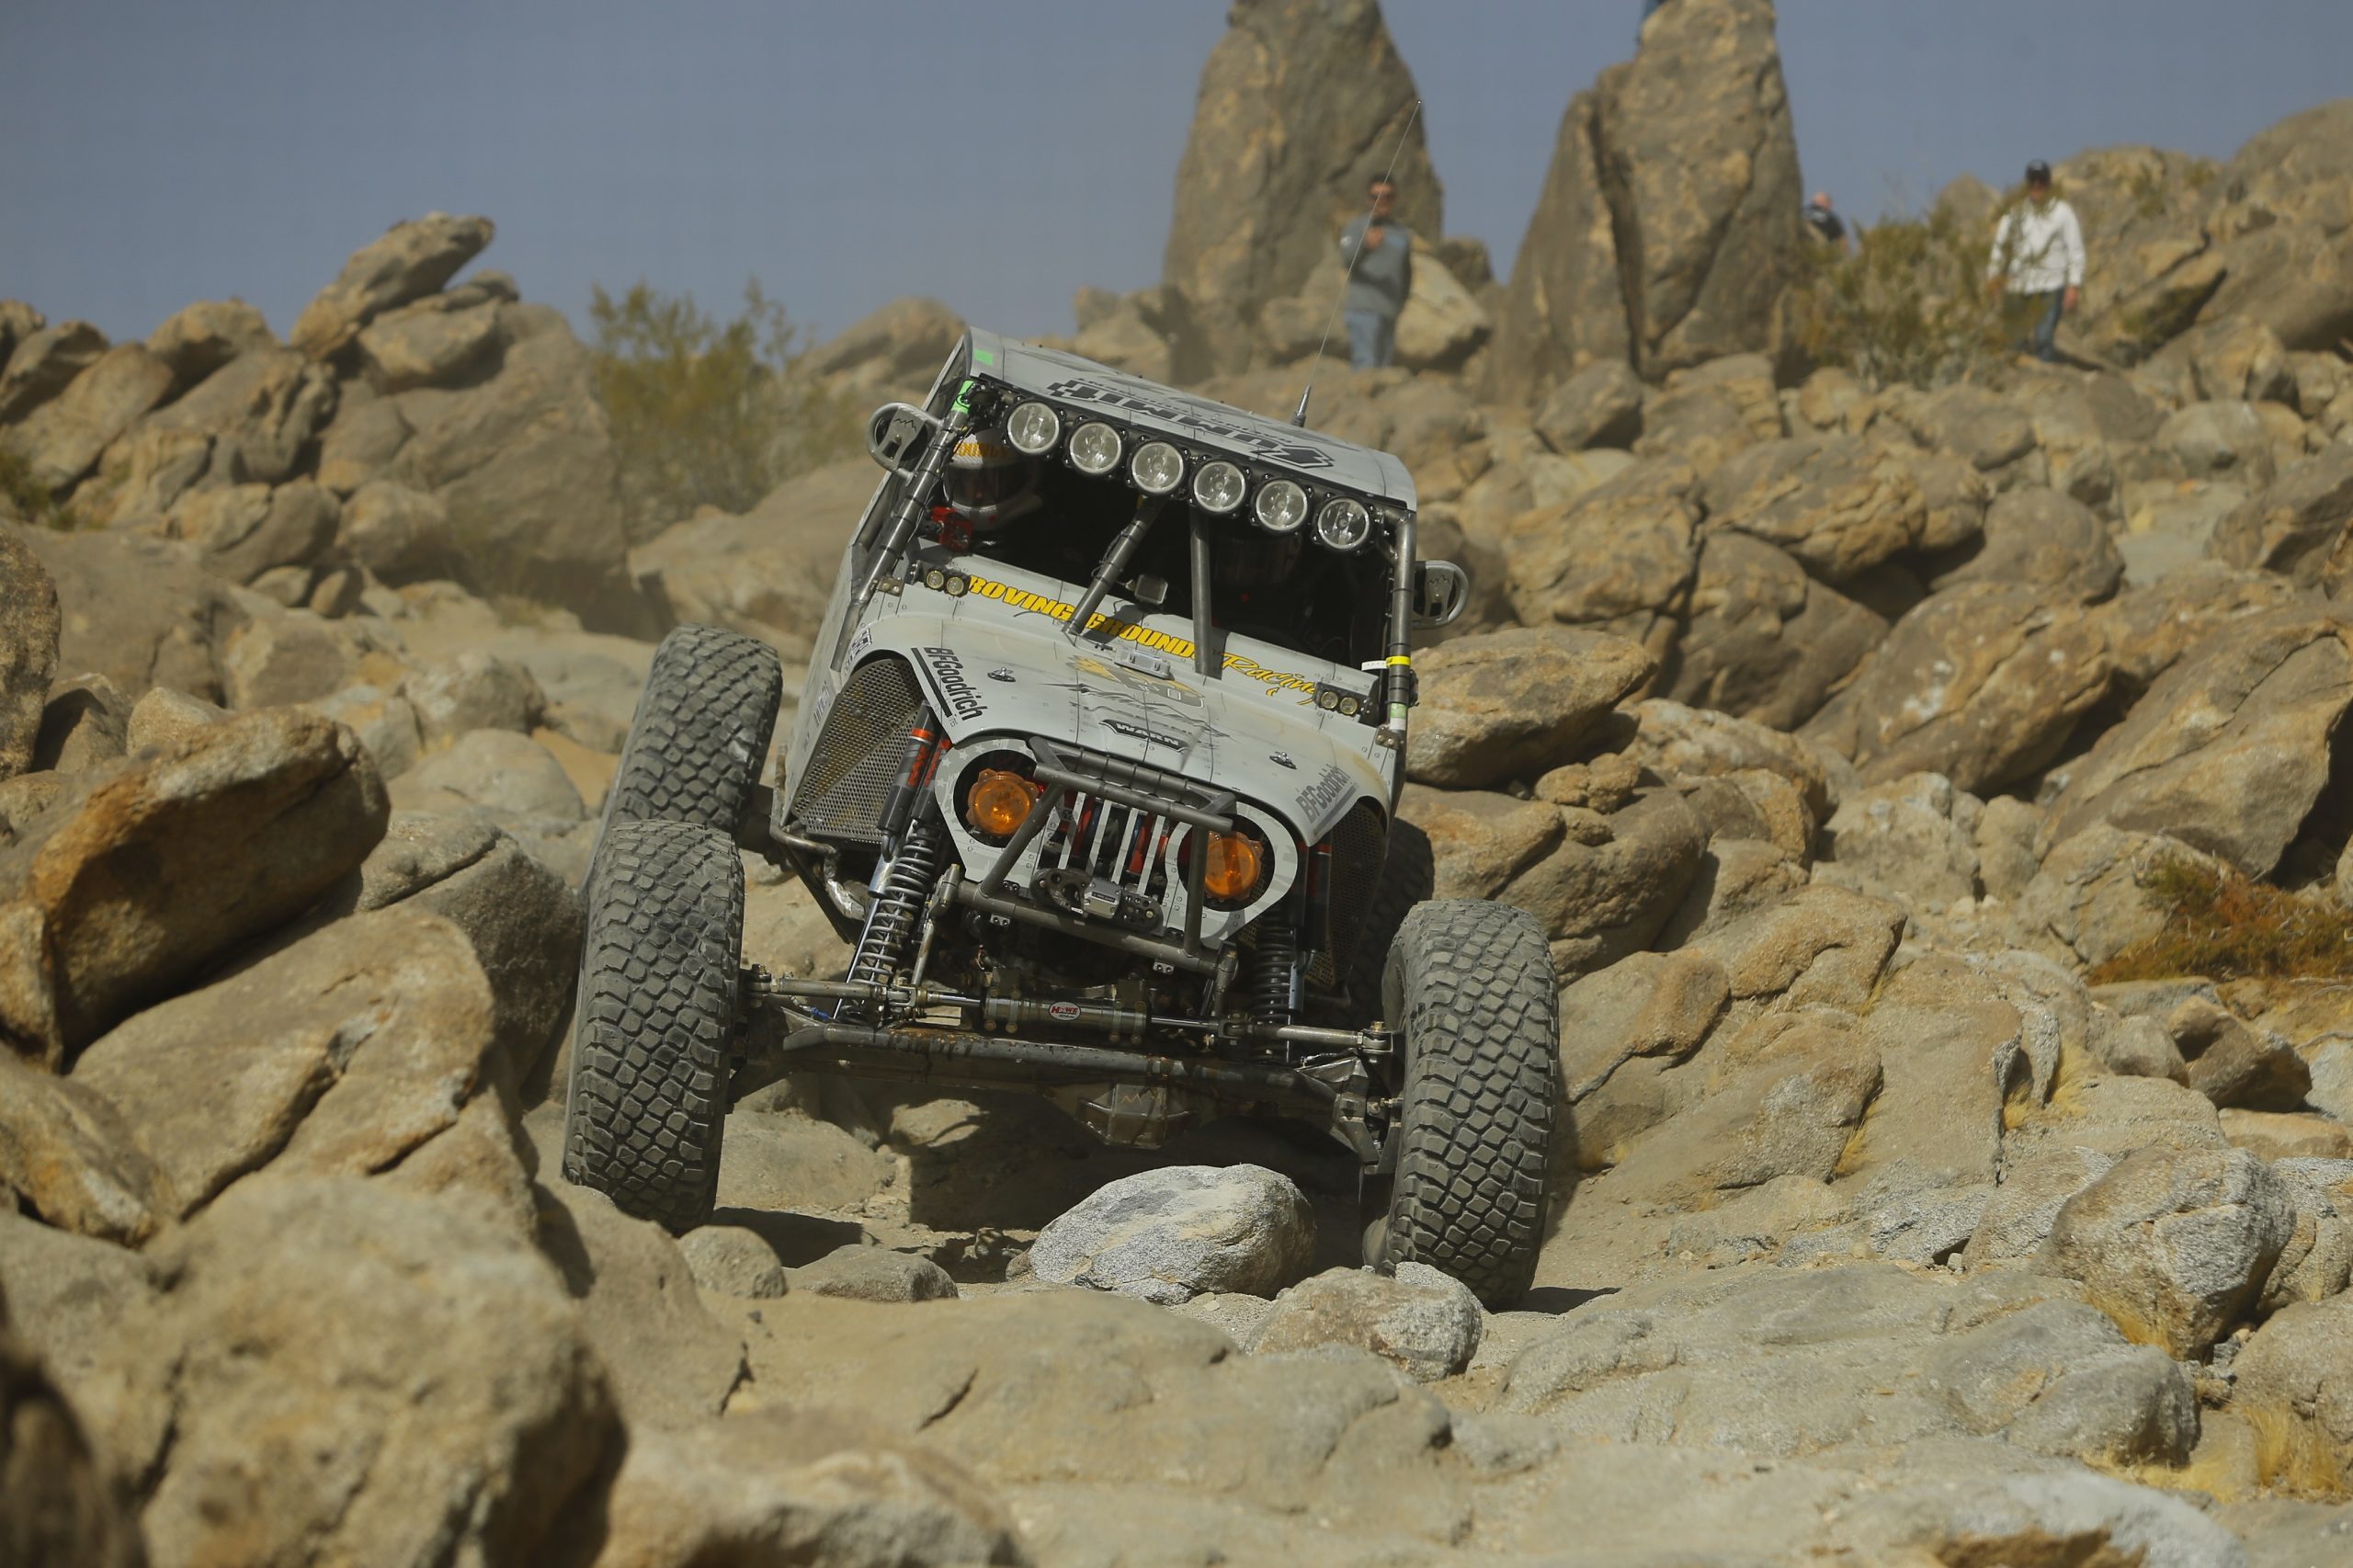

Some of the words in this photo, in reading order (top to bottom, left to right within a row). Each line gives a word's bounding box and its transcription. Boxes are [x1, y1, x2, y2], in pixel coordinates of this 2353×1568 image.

[968, 574, 1075, 622] ROVING
[1085, 611, 1196, 660] GROUND
[1220, 652, 1316, 706] Racin
[923, 647, 988, 721] BFGoodrich
[1116, 722, 1180, 746] WARN
[1295, 764, 1351, 824] BFGoodrich
